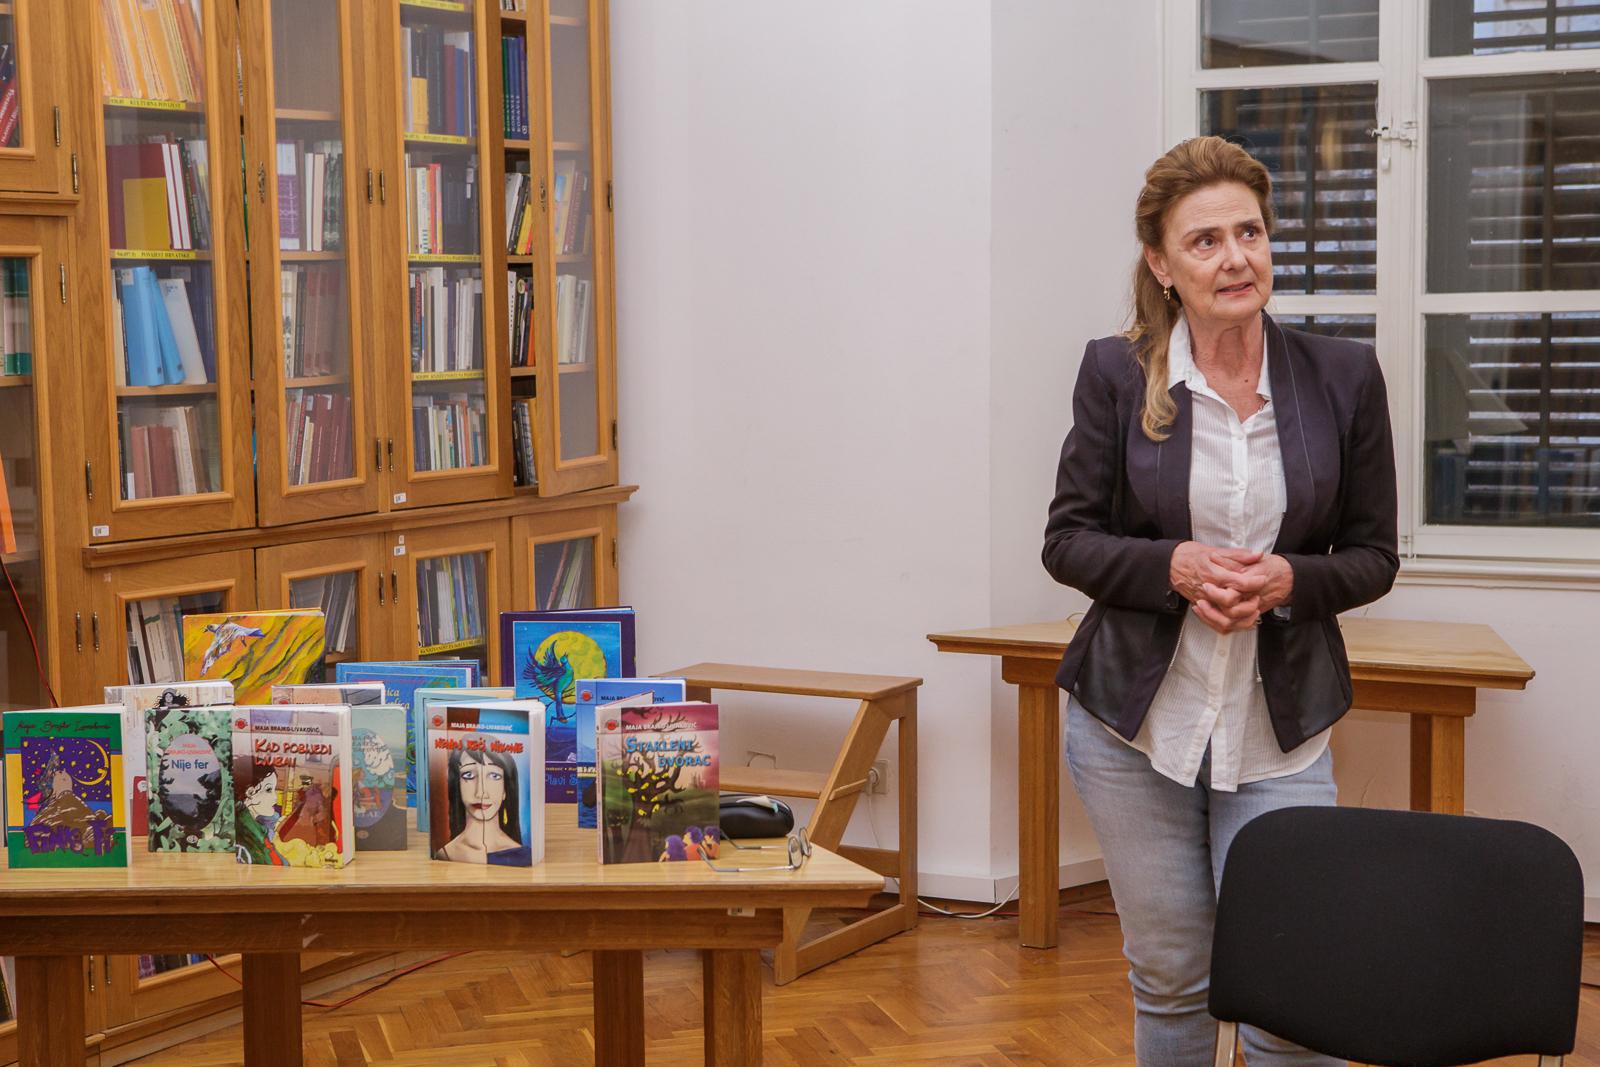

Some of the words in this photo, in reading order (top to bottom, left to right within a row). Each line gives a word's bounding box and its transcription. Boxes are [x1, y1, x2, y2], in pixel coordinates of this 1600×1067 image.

[255, 738, 280, 752] KAD
[283, 743, 332, 756] POBIJEDI
[626, 736, 694, 753] STAKLENI
[171, 760, 192, 772] Nije
[194, 760, 208, 770] fer
[658, 754, 712, 769] DVORAC
